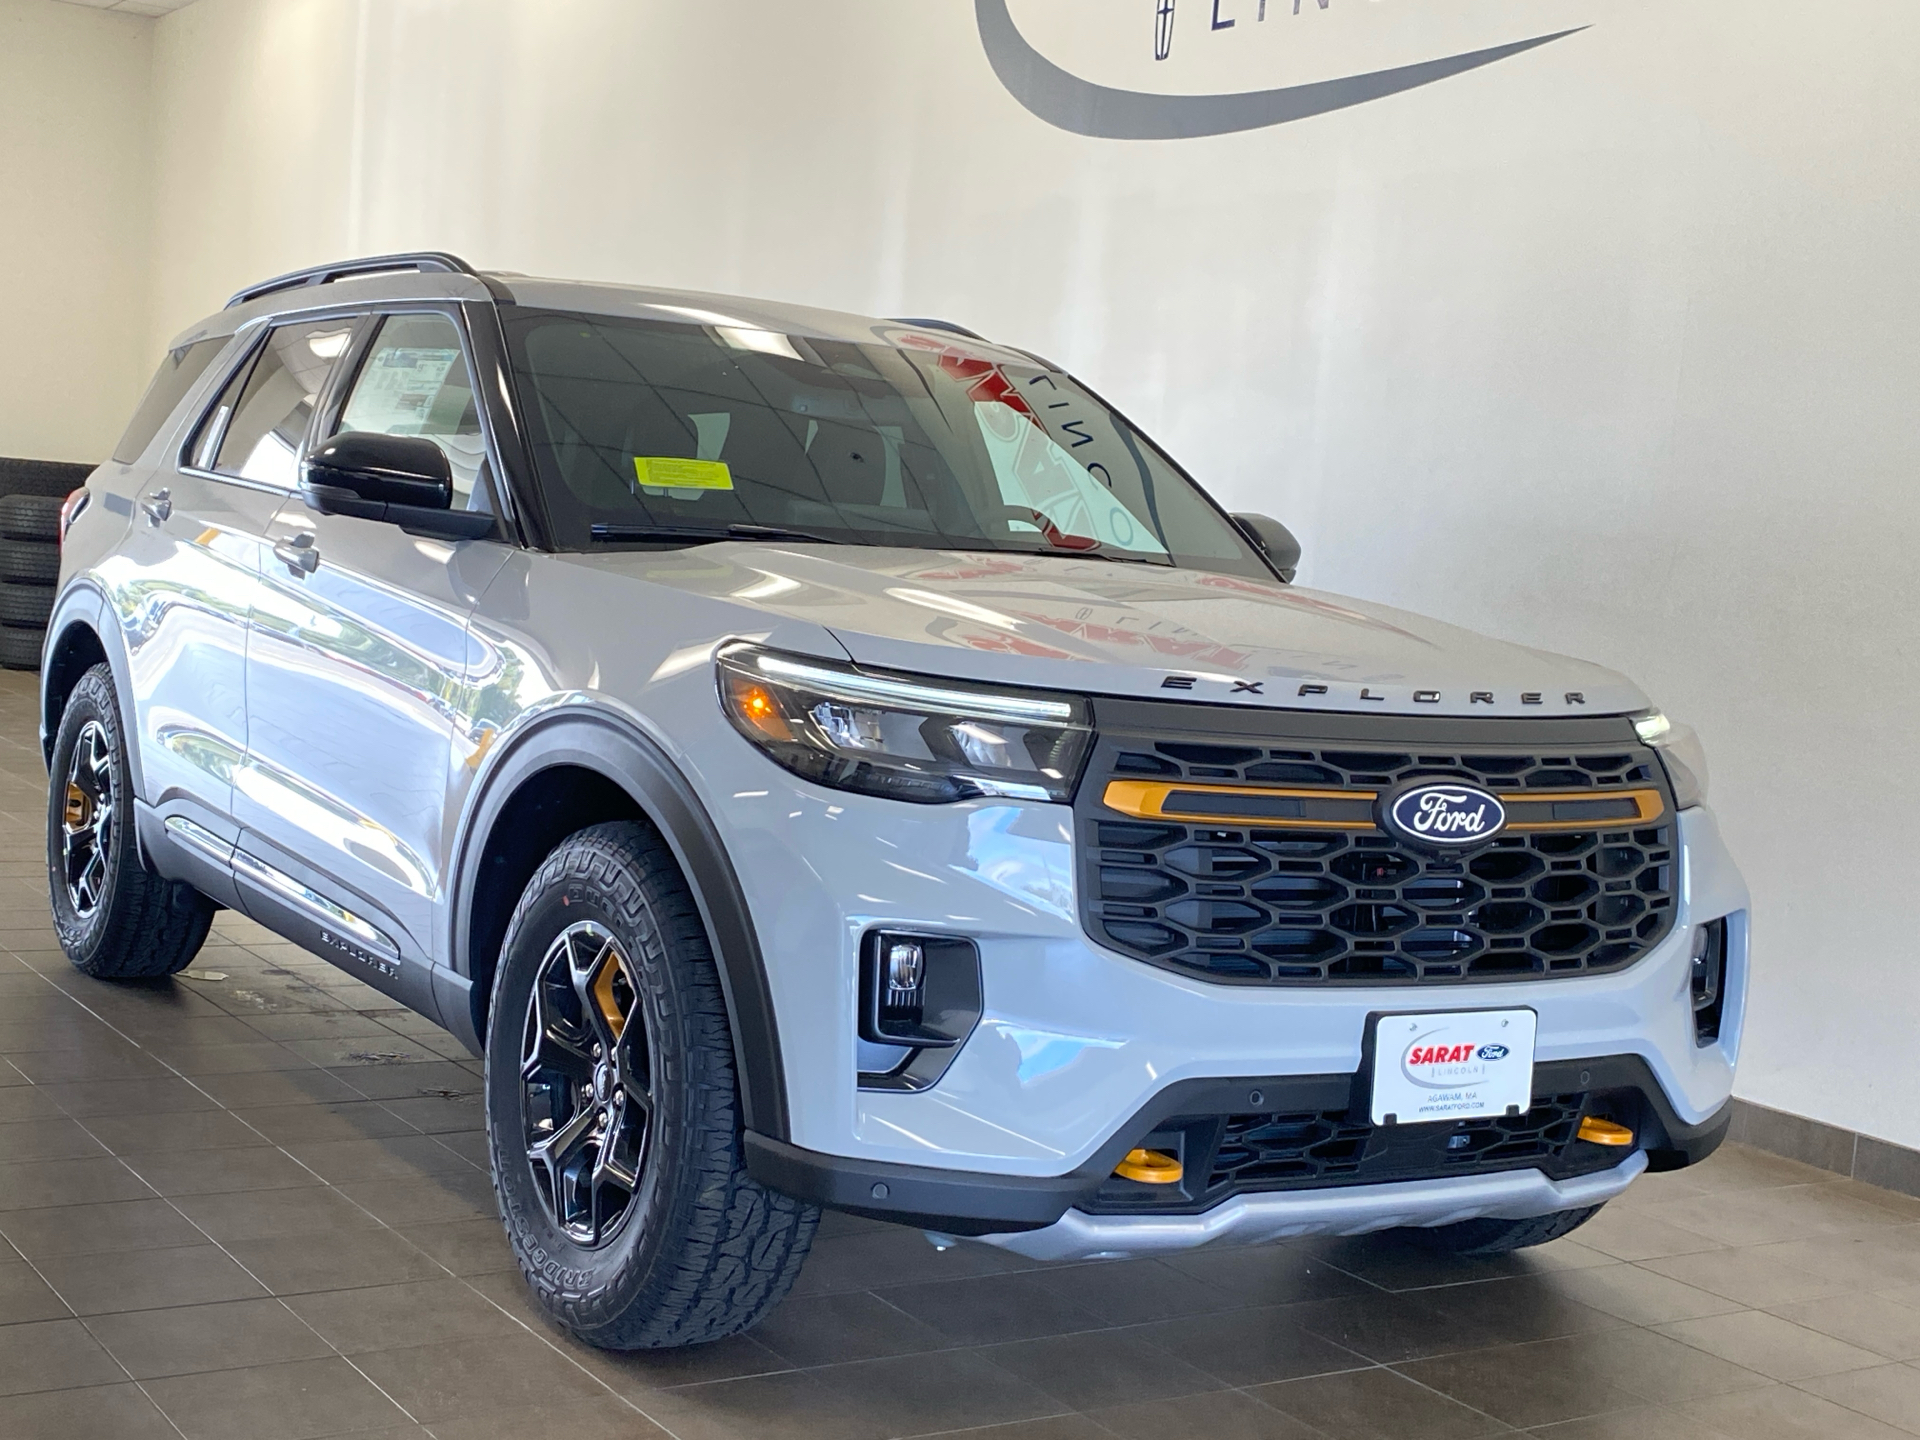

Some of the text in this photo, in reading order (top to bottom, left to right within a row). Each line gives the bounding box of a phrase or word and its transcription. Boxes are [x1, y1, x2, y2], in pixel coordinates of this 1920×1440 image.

[1161, 675, 1586, 704] EXPLORER
[1413, 792, 1486, 832] Ford
[1409, 1045, 1475, 1065] SARAT
[1438, 1066, 1479, 1076] LINCOLN
